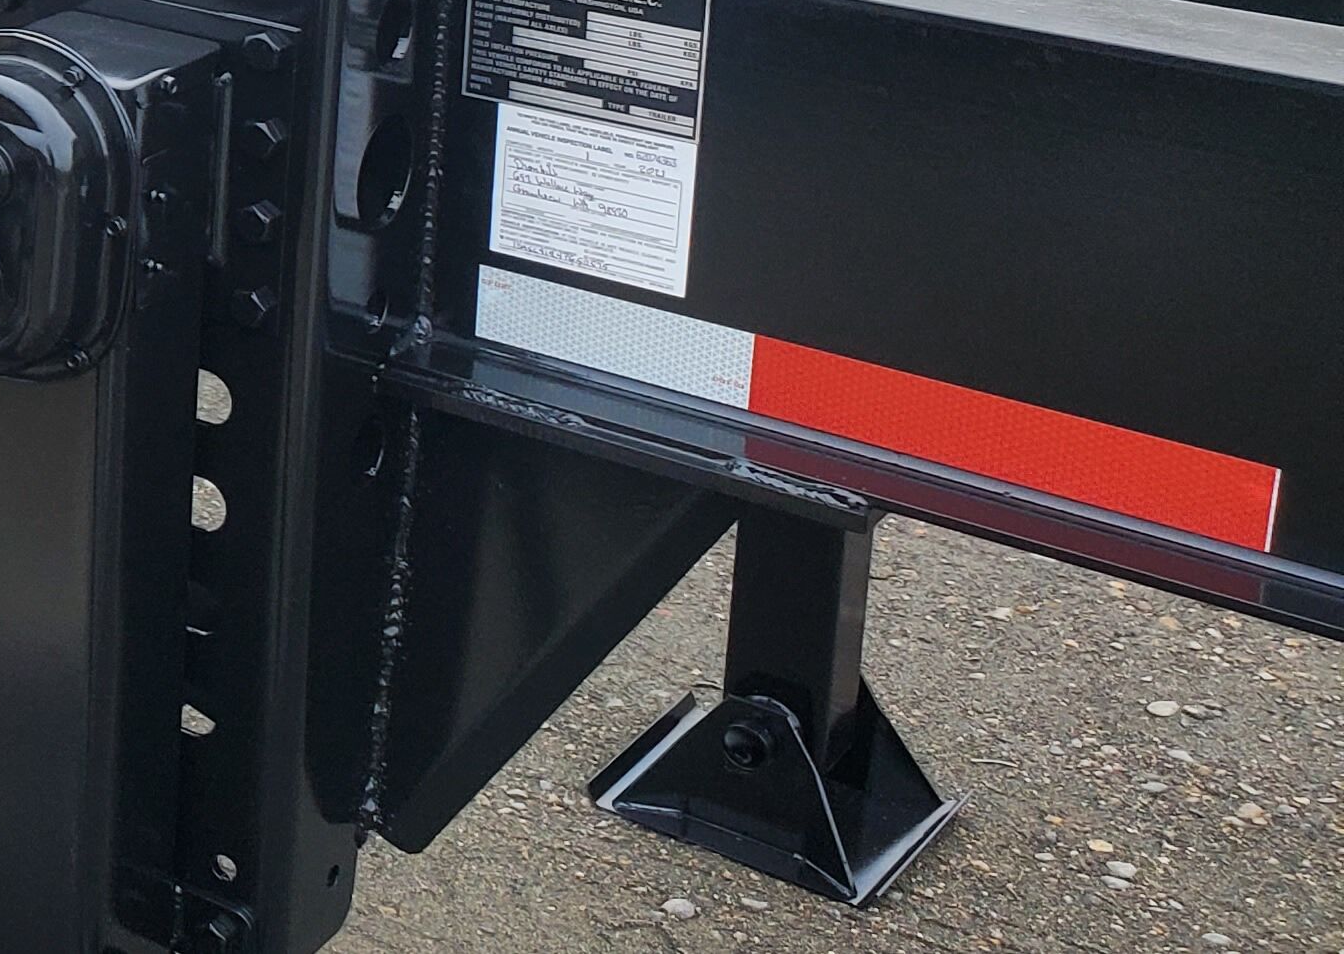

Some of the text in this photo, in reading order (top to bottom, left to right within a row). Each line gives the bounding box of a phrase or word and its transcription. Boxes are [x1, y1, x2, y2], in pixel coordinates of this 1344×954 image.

[627, 6, 643, 16] USA
[607, 101, 625, 111] TYPE
[648, 111, 676, 122] TRAILER
[530, 131, 555, 141] VEHICLE
[557, 136, 592, 149] INSPECTION
[593, 144, 613, 154] LABEL
